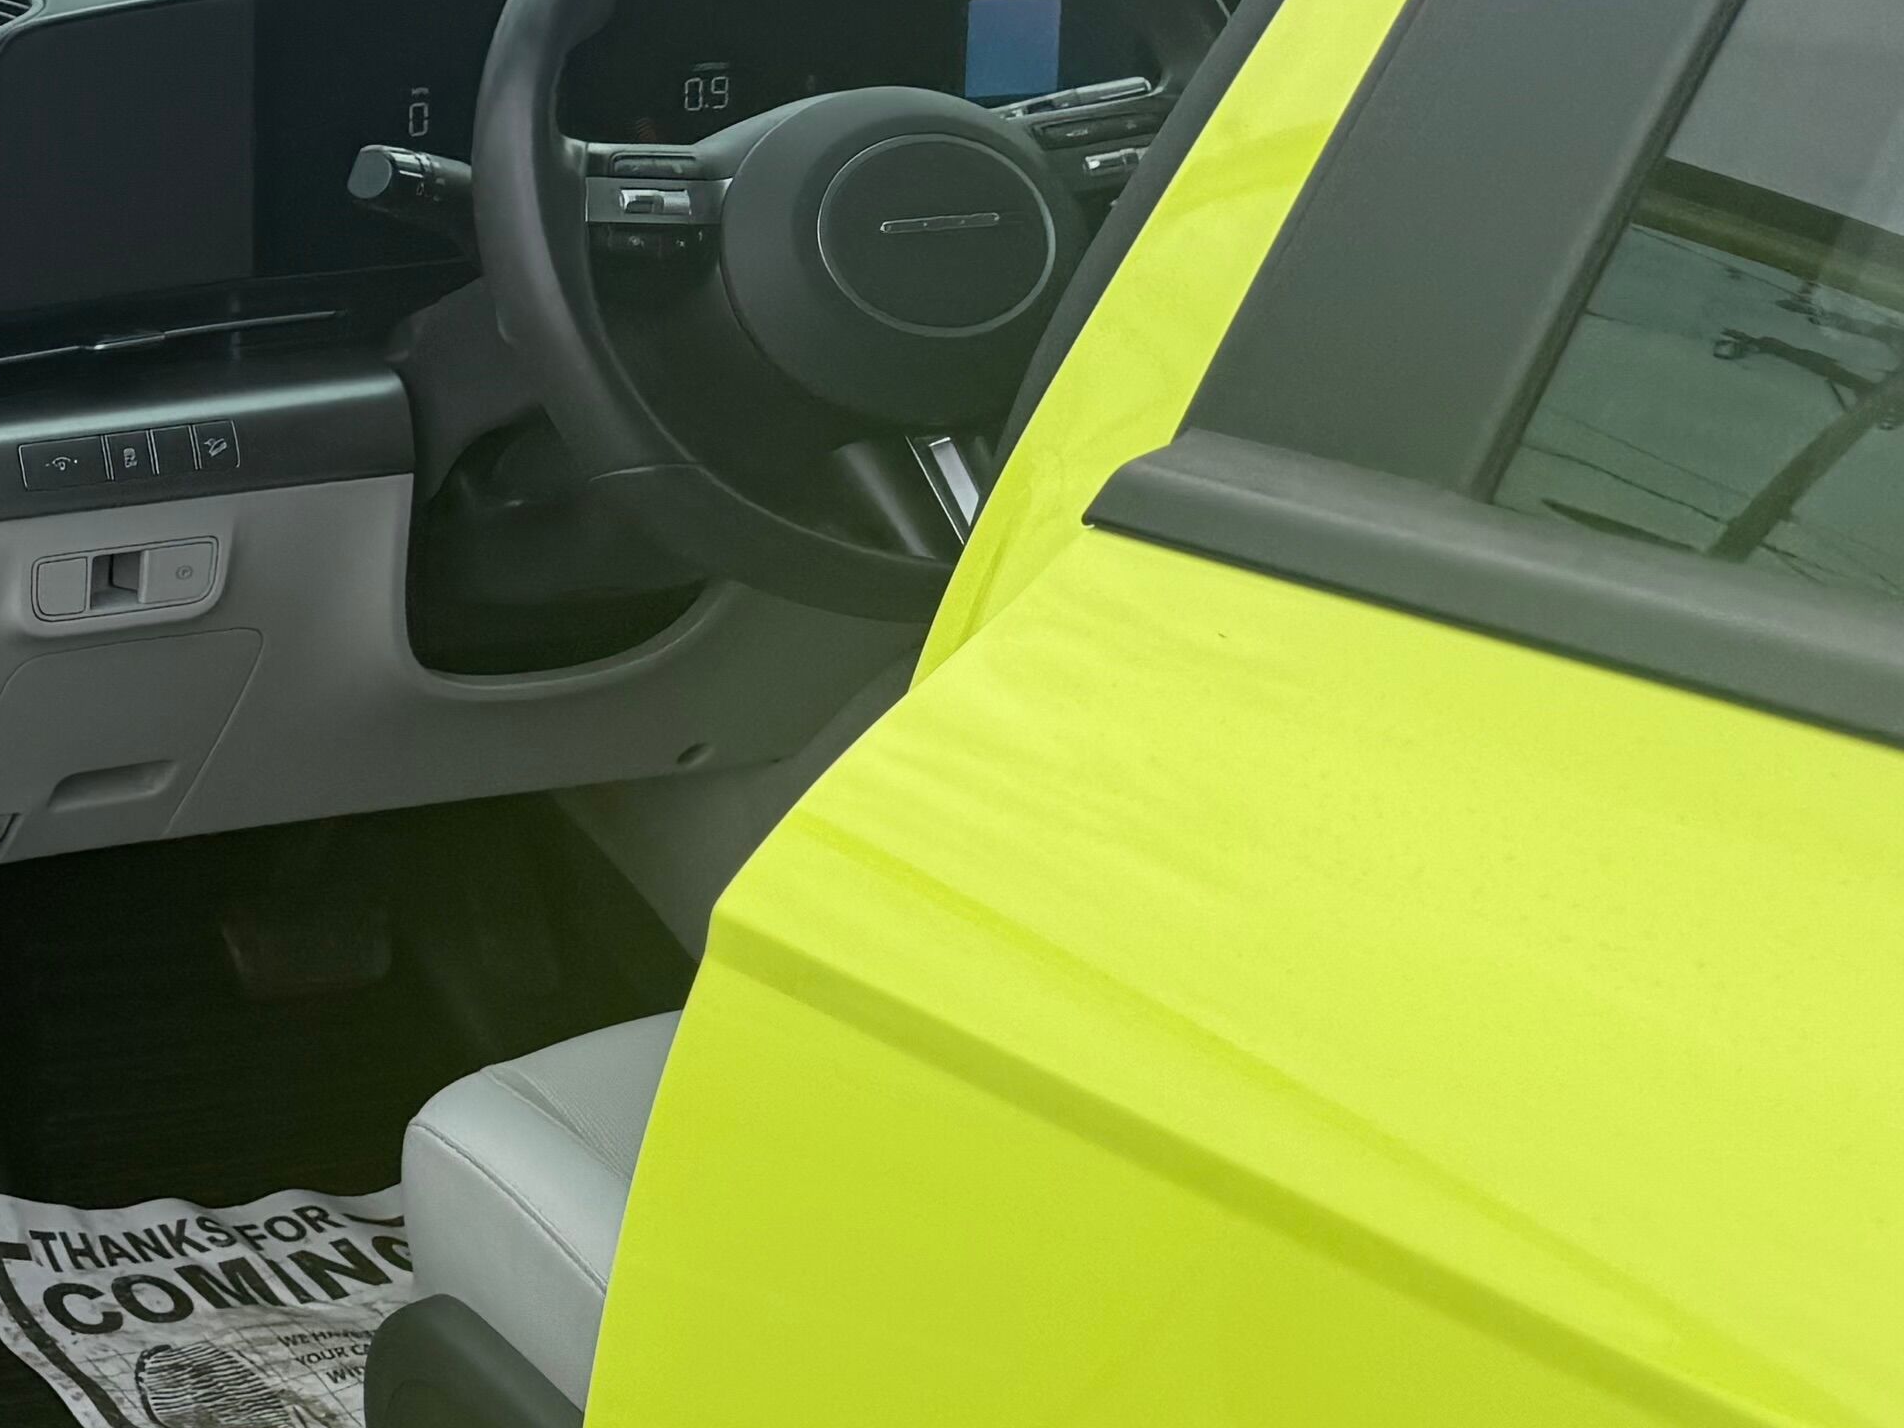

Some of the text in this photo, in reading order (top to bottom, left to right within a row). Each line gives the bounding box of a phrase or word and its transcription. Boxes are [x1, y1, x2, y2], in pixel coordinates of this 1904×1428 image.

[408, 101, 429, 137] 0
[28, 1203, 348, 1273] THANKS FOR
[295, 1346, 350, 1366] YOUR
